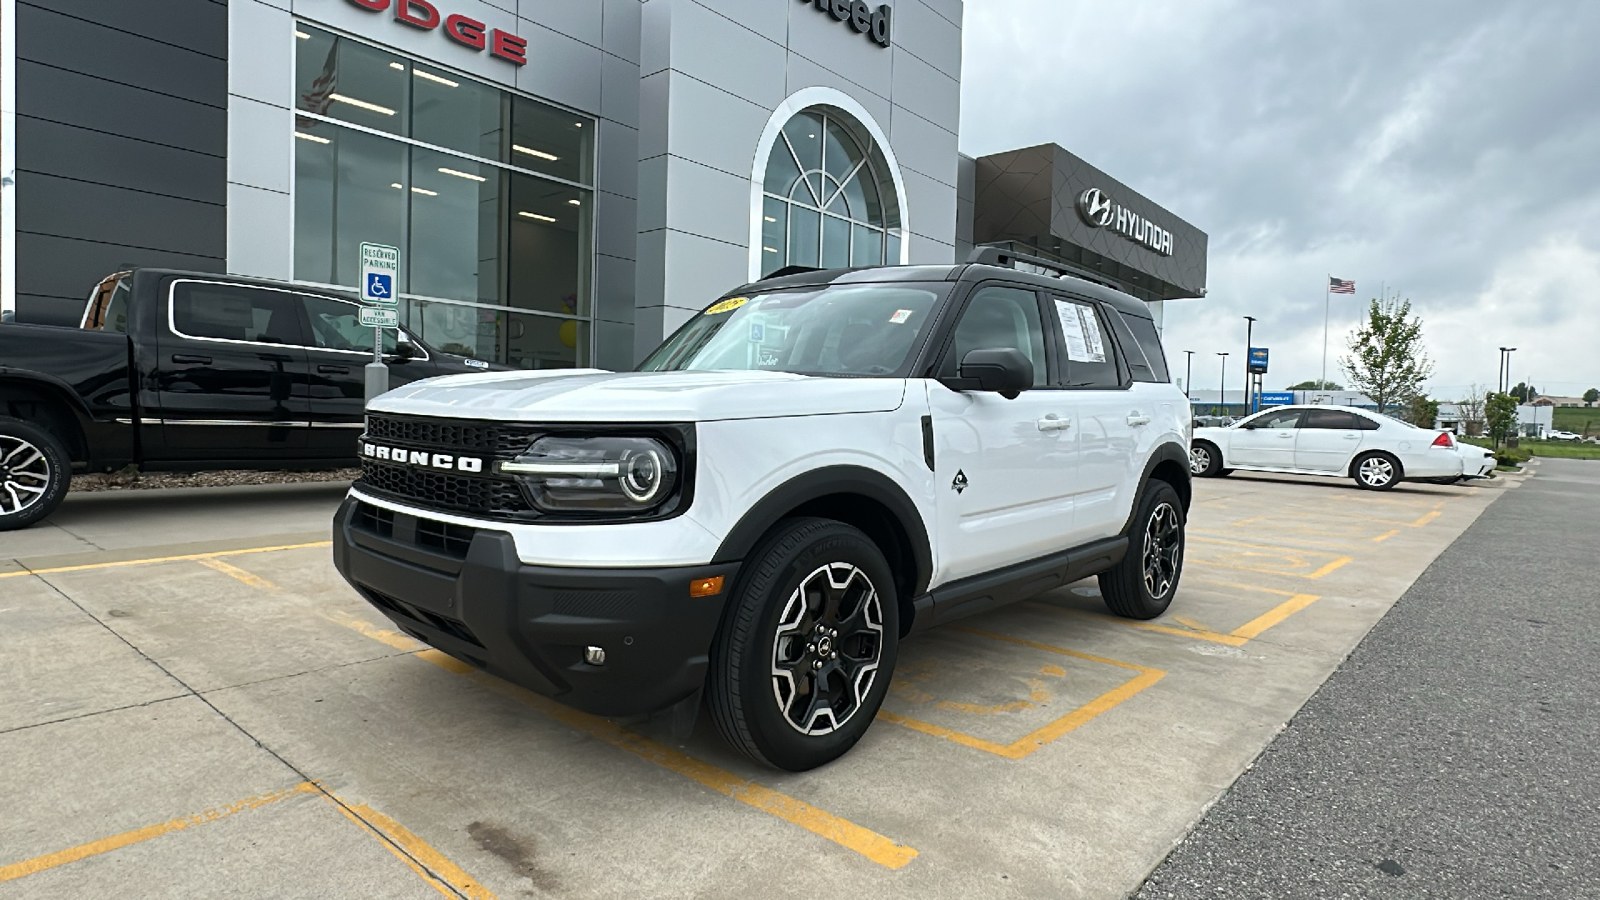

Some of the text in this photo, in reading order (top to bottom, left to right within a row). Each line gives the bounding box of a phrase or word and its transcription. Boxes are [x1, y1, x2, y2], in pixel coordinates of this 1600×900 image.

[798, 0, 891, 48] eed
[1116, 204, 1173, 256] HYUNDAI
[364, 248, 396, 260] RESERVED
[364, 258, 396, 271] PARKING
[362, 316, 396, 325] ACCESSIBLE
[364, 443, 482, 473] BRONCO
